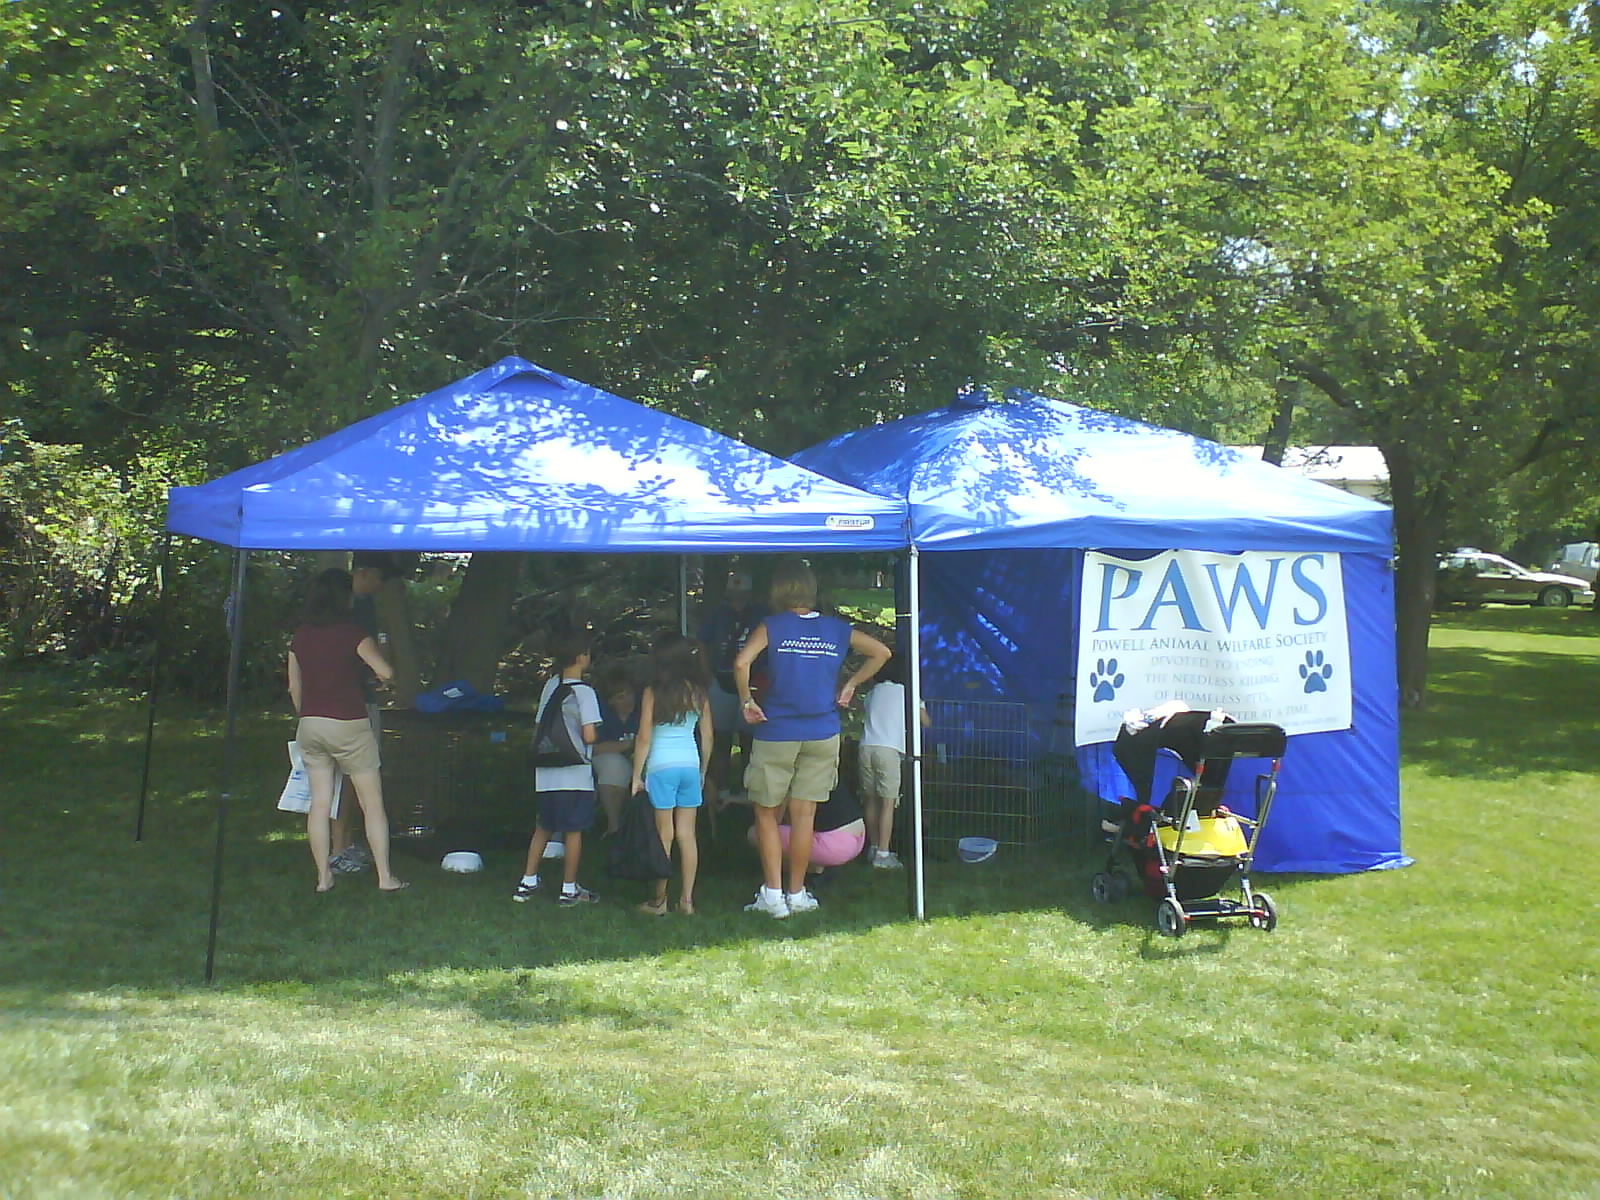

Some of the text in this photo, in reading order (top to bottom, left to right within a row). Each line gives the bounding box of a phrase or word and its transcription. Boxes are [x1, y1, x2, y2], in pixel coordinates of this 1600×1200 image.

[1092, 554, 1328, 633] PAWS
[1092, 638, 1146, 653] POWELL
[1149, 637, 1209, 651] ANIMAL
[1275, 631, 1328, 648] SOCIETY
[1215, 659, 1232, 671] TO
[1172, 673, 1235, 687] NEEDLESS
[1174, 690, 1241, 704] HOMELESS
